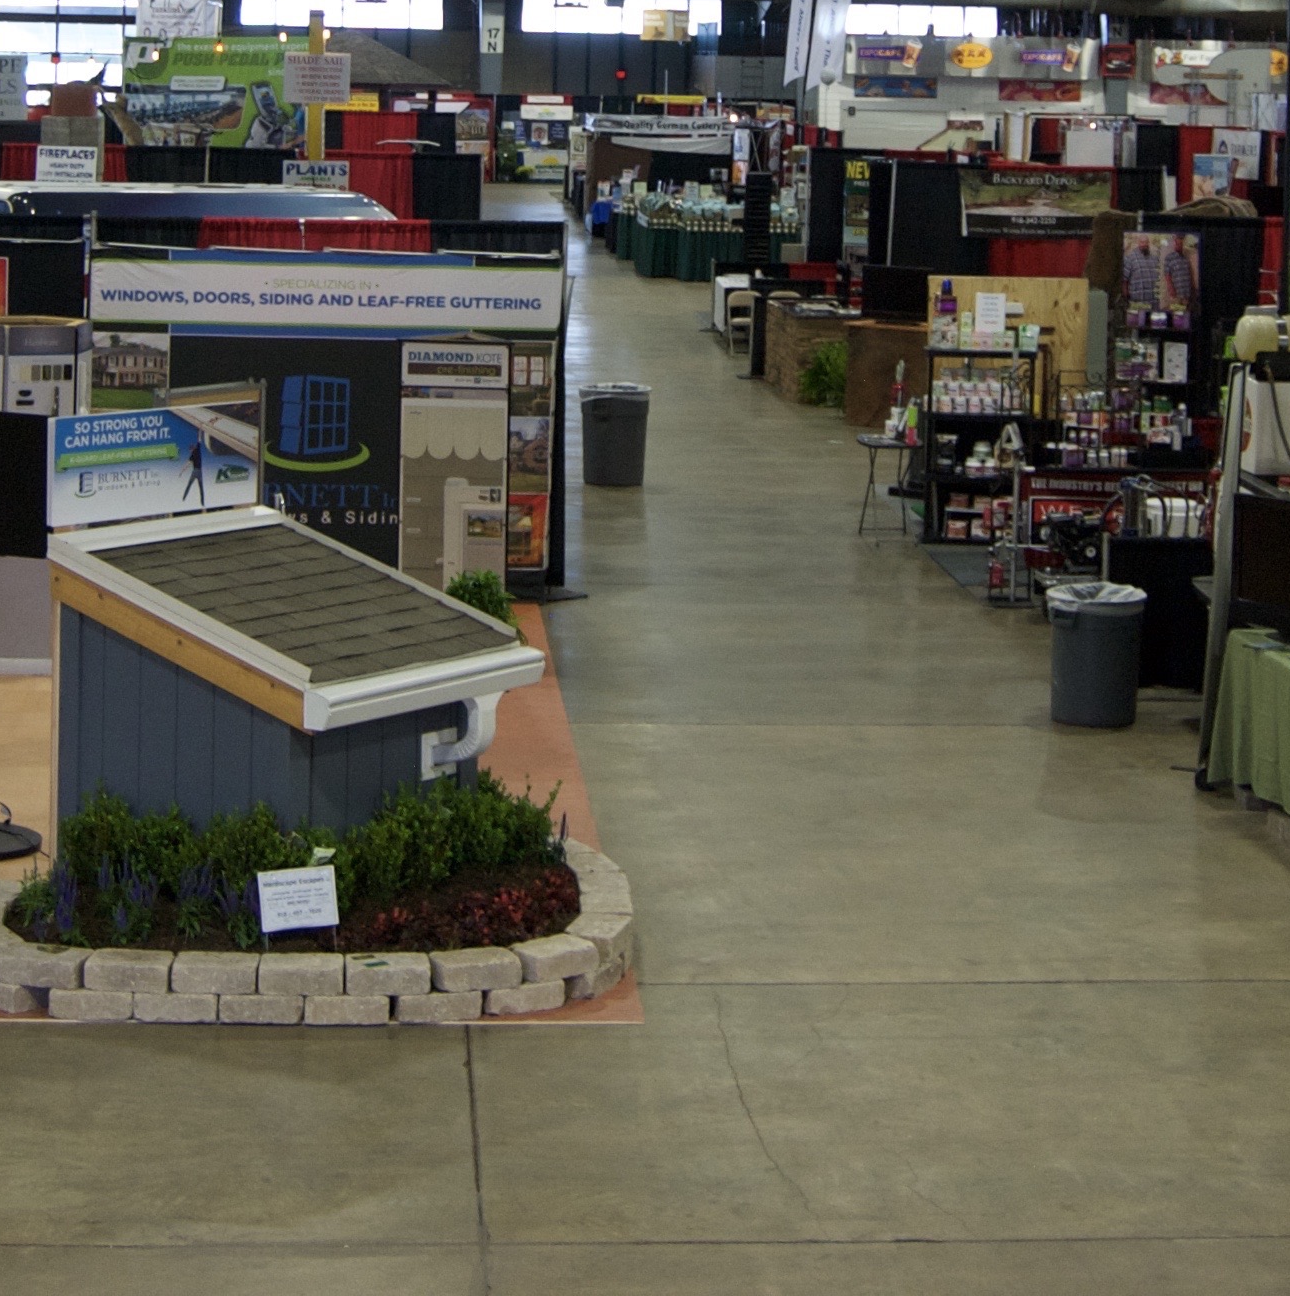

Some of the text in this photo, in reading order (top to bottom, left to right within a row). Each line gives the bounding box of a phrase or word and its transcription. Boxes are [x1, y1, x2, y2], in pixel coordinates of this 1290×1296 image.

[487, 28, 500, 39] 17
[488, 41, 497, 52] N
[287, 55, 321, 65] SHADE
[623, 120, 654, 132] Quality
[656, 120, 689, 130] German
[39, 148, 96, 159] FIREPLACES
[286, 163, 347, 177] PLANTS
[272, 277, 372, 291] SPECIALIZING IN
[100, 289, 542, 310] WINDOWS, DOORS, SIDING AND LEAF-FREE GUTTERING
[407, 350, 504, 364] DIAMOND KOTE
[437, 364, 496, 376] pre-finishing
[74, 415, 163, 435] SO STRONG YOU
[64, 427, 171, 449] CAN HANG FROM IT.
[97, 468, 151, 484] BURNETT
[320, 510, 399, 526] & Sidin
